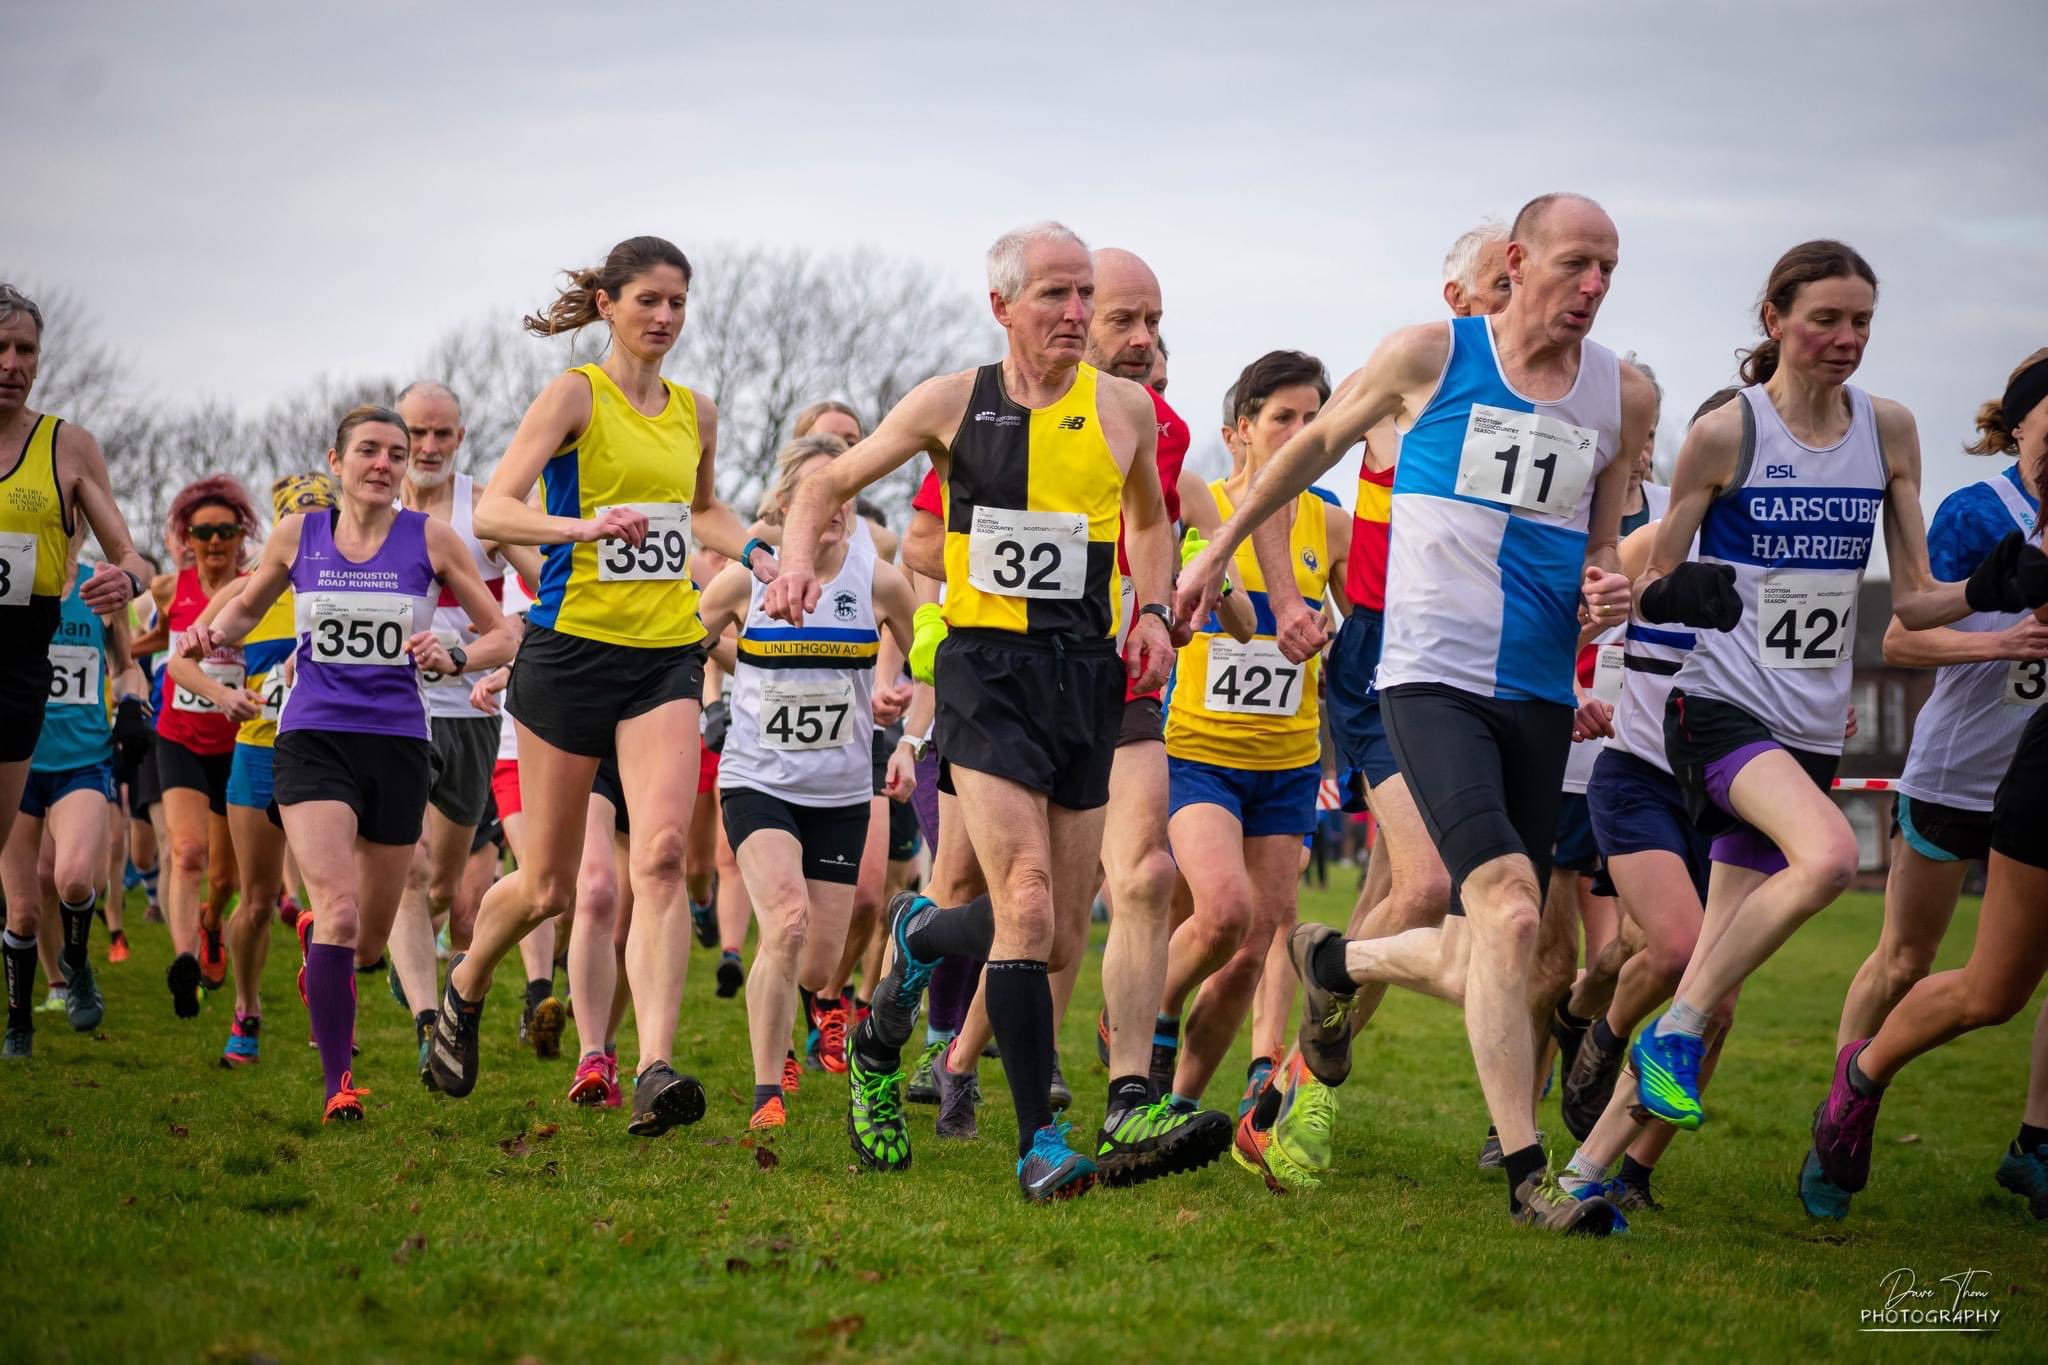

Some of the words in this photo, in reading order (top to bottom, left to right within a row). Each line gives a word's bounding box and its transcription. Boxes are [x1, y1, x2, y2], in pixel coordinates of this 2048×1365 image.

[1474, 427, 1497, 436] SEASON
[1475, 416, 1503, 426] SCOTTISH
[1494, 444, 1558, 504] 11
[1766, 465, 1797, 479] PSL
[1750, 497, 1880, 523] GARSCUBE
[606, 530, 686, 574] 359
[319, 569, 398, 580] BELLAHOUSTON
[993, 541, 1062, 591] 32
[317, 578, 346, 587] ROAD
[349, 580, 399, 589] RUNNERS
[316, 618, 403, 660] 350
[764, 643, 841, 655] LINLITHGOW
[842, 644, 858, 655] AC
[1212, 665, 1297, 708] 427
[766, 703, 849, 744] 457
